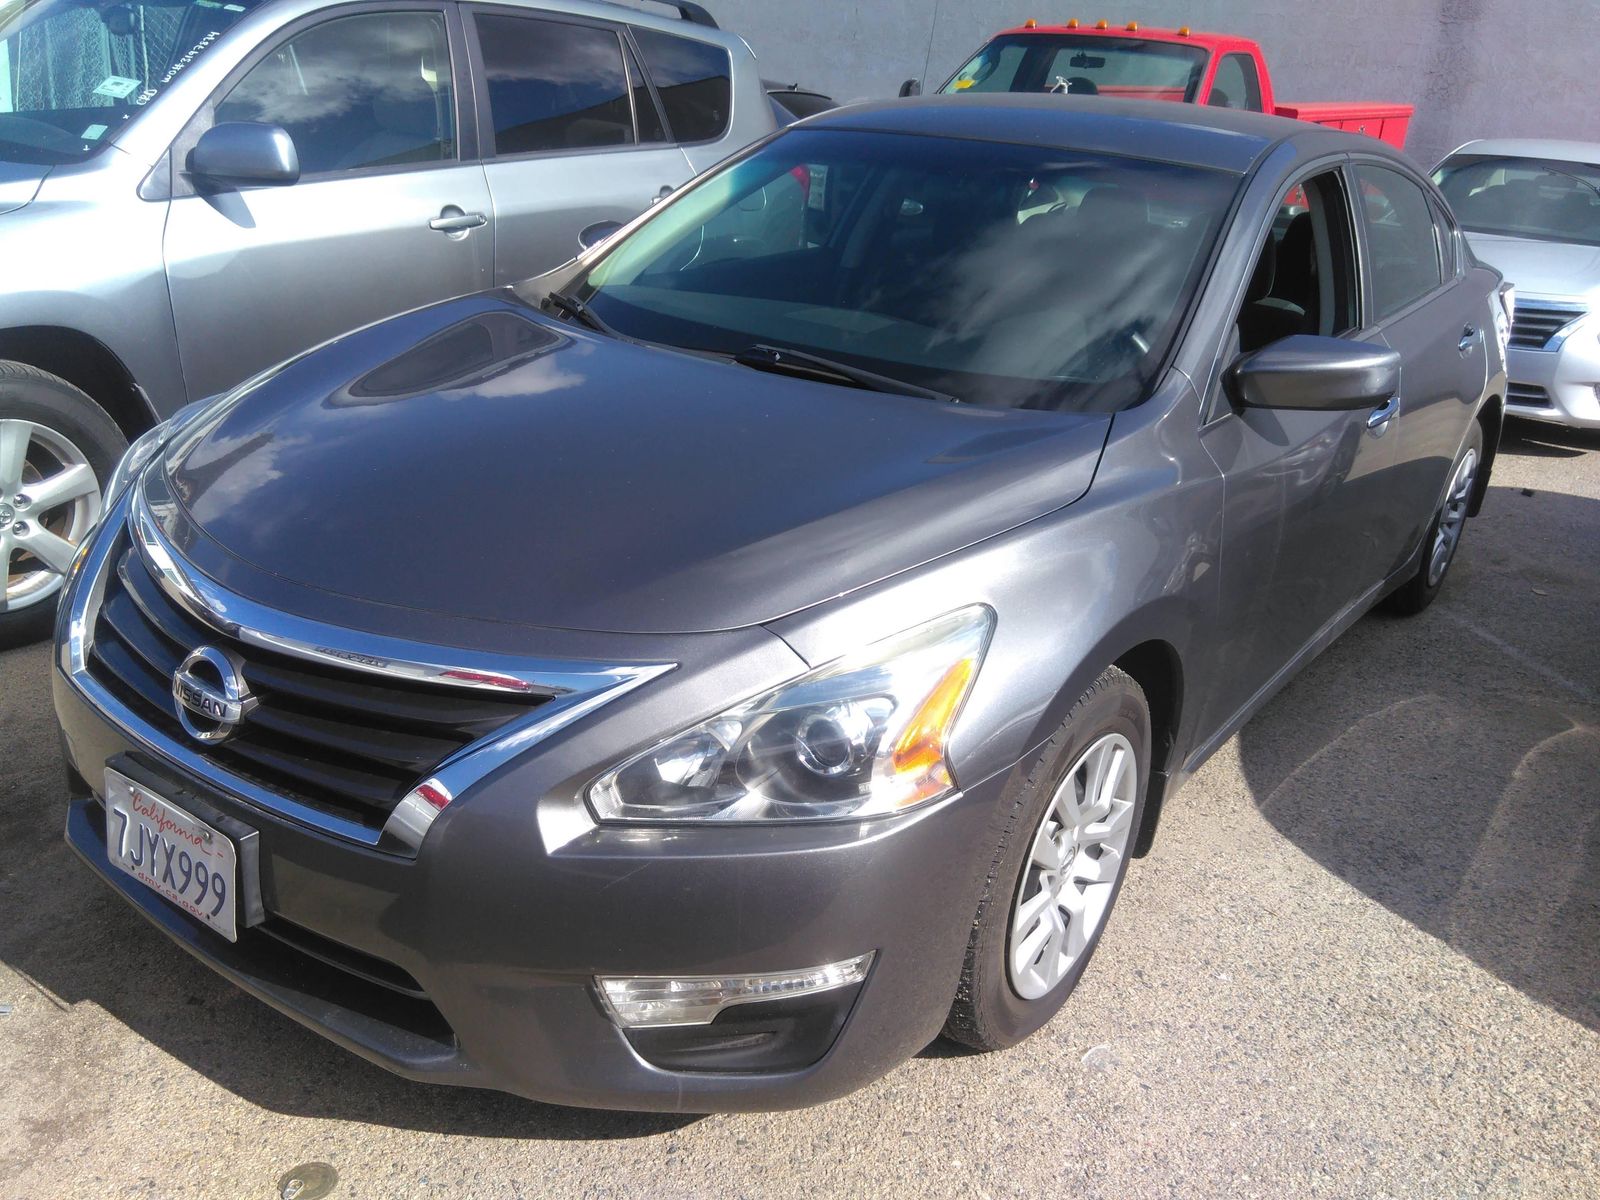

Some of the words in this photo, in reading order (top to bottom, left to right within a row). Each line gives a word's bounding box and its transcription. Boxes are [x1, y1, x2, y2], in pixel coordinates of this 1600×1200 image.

[174, 678, 228, 717] NISSAN
[132, 793, 212, 856] California
[113, 807, 226, 917] 7JYX999
[137, 871, 203, 917] dmv.ca.gov
